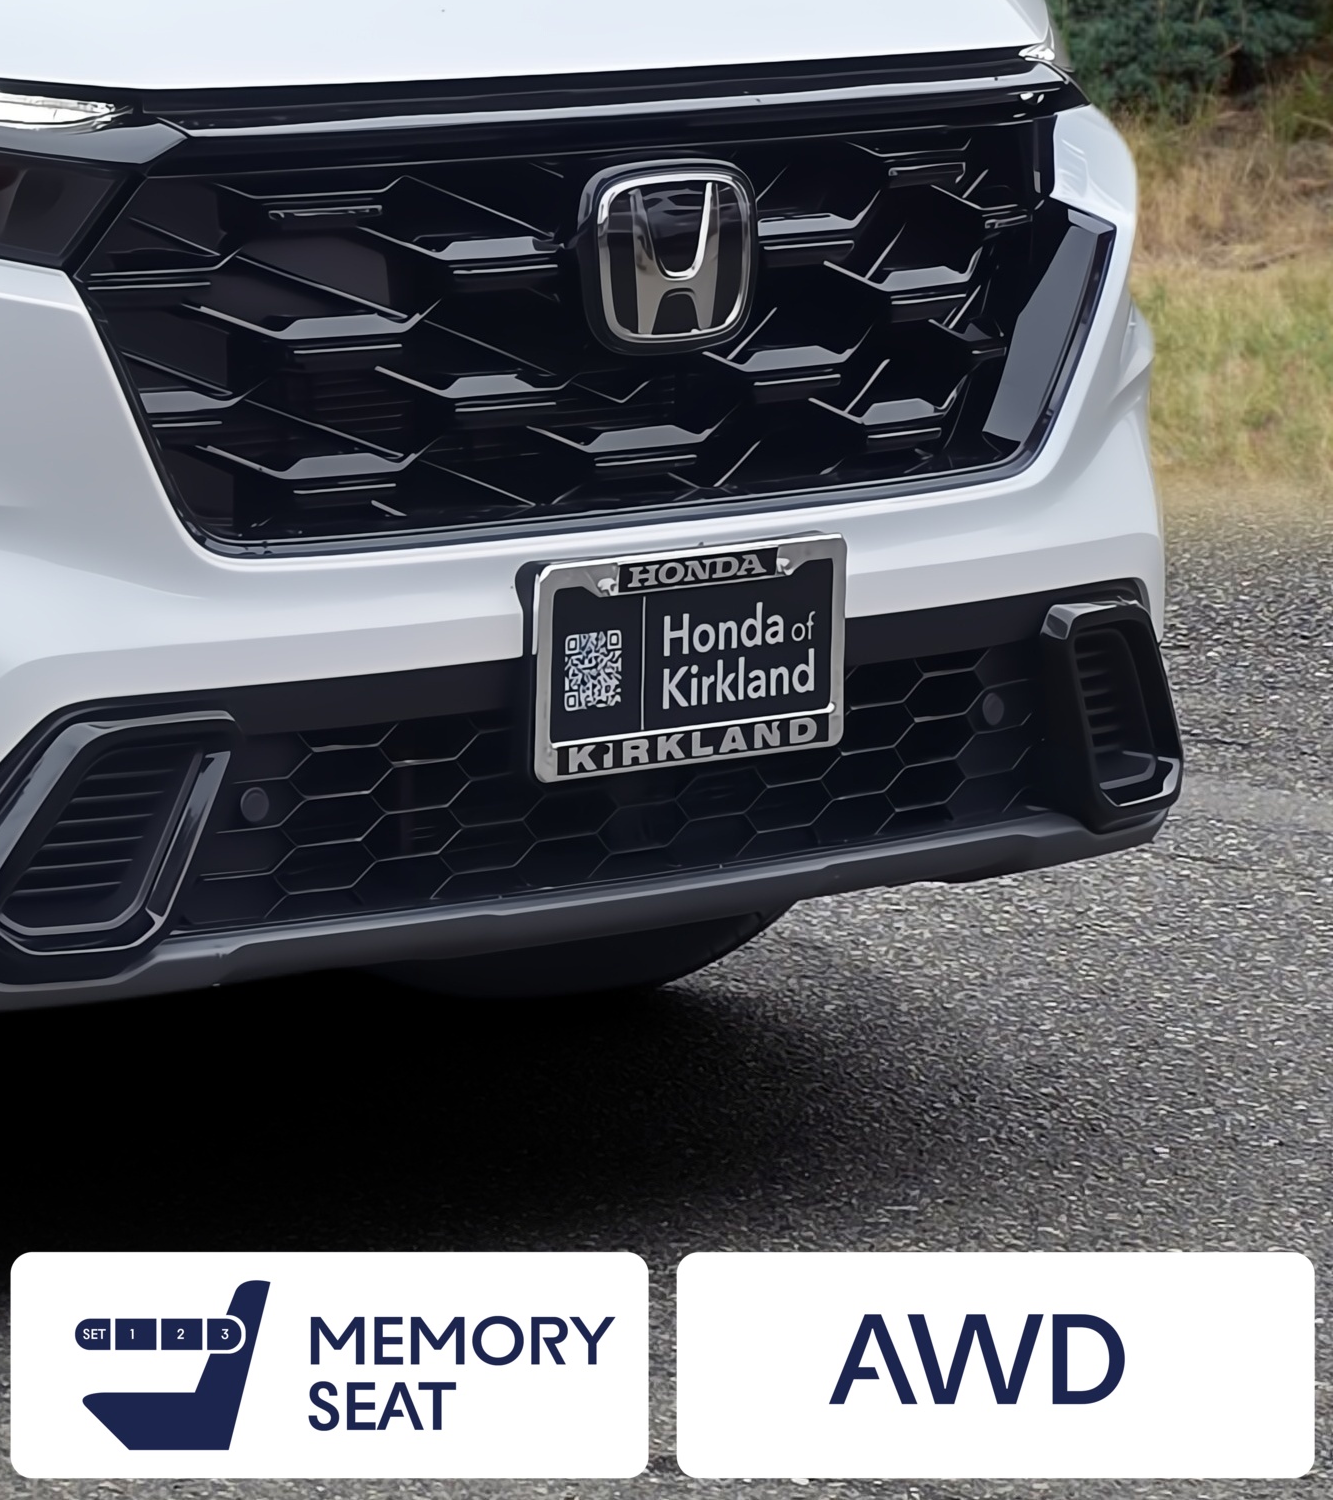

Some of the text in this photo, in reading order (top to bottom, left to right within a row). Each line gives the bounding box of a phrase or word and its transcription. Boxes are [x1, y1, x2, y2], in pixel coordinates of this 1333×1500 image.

[627, 553, 768, 589] HONDA
[662, 601, 817, 657] Honda of
[661, 647, 816, 710] Kirkland
[567, 716, 819, 774] KIRKLAND
